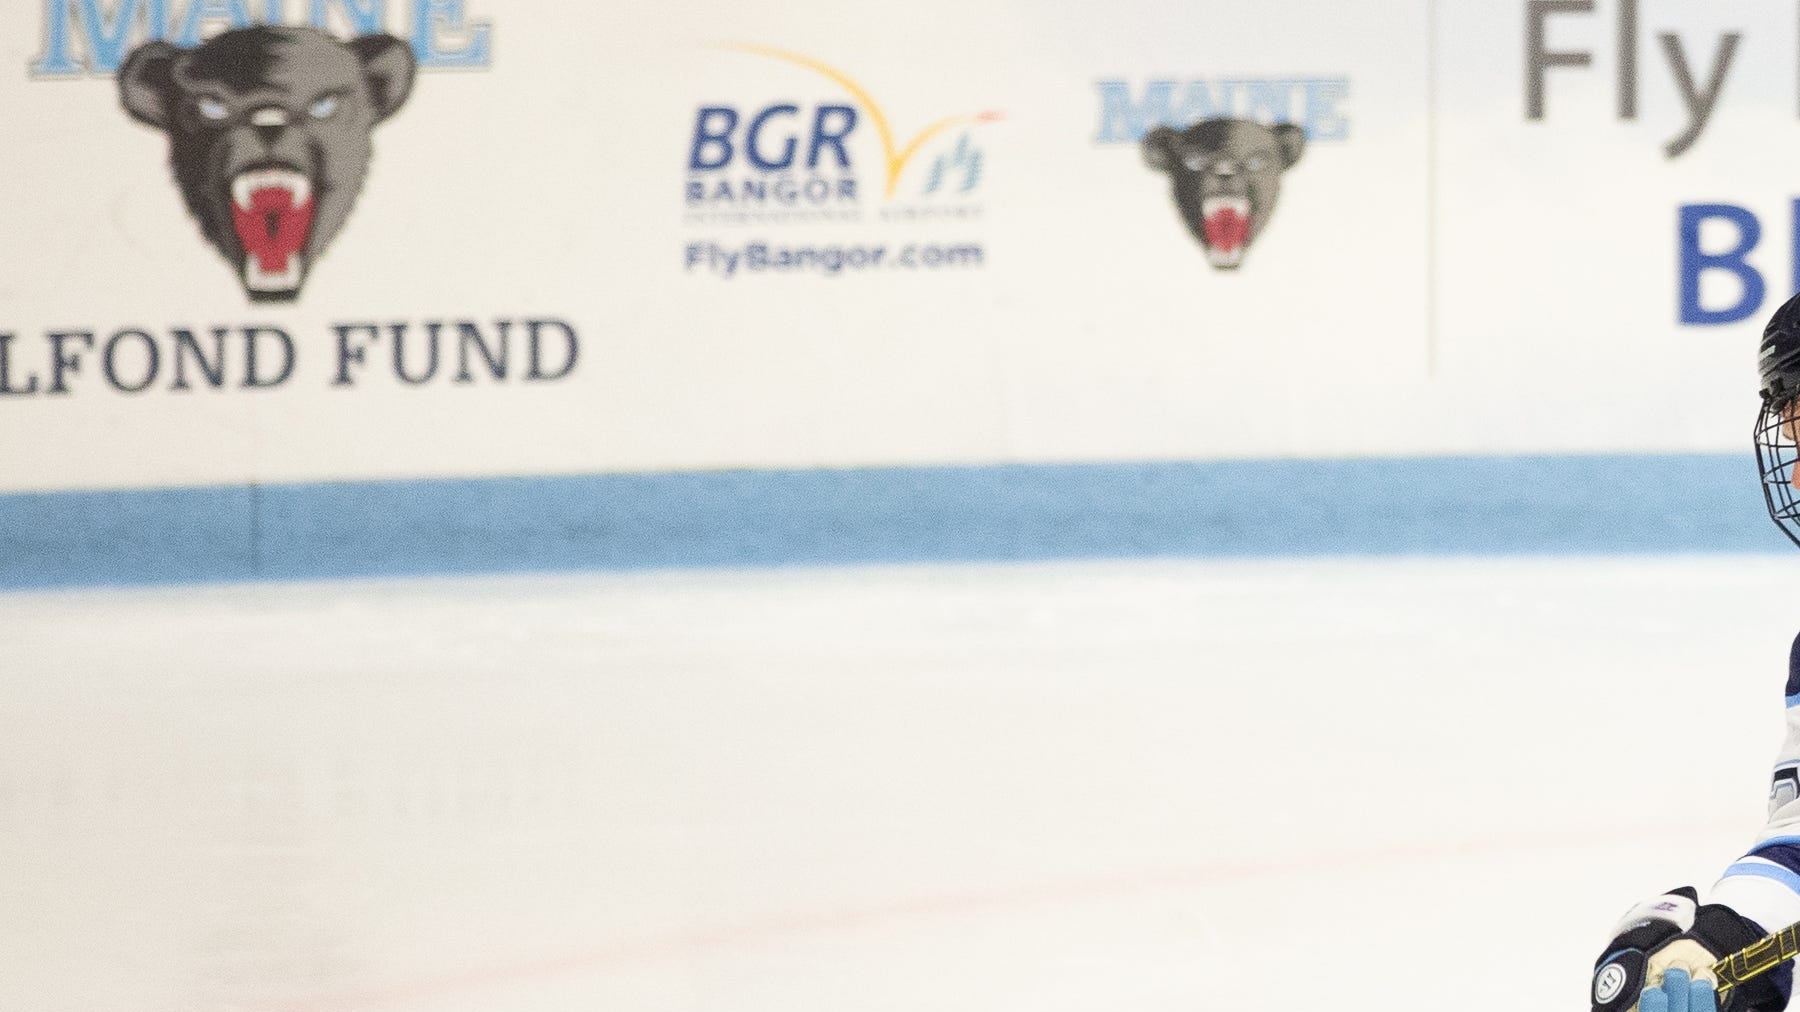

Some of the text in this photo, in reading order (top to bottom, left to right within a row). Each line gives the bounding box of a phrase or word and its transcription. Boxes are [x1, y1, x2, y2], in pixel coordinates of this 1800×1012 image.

[28, 0, 492, 78] MAE
[1524, 0, 1743, 160] Fly
[689, 103, 858, 171] BGR
[685, 179, 858, 202] BANGOR
[684, 241, 985, 276] FlyBangor.com
[0, 317, 581, 395] LFOND FUND
